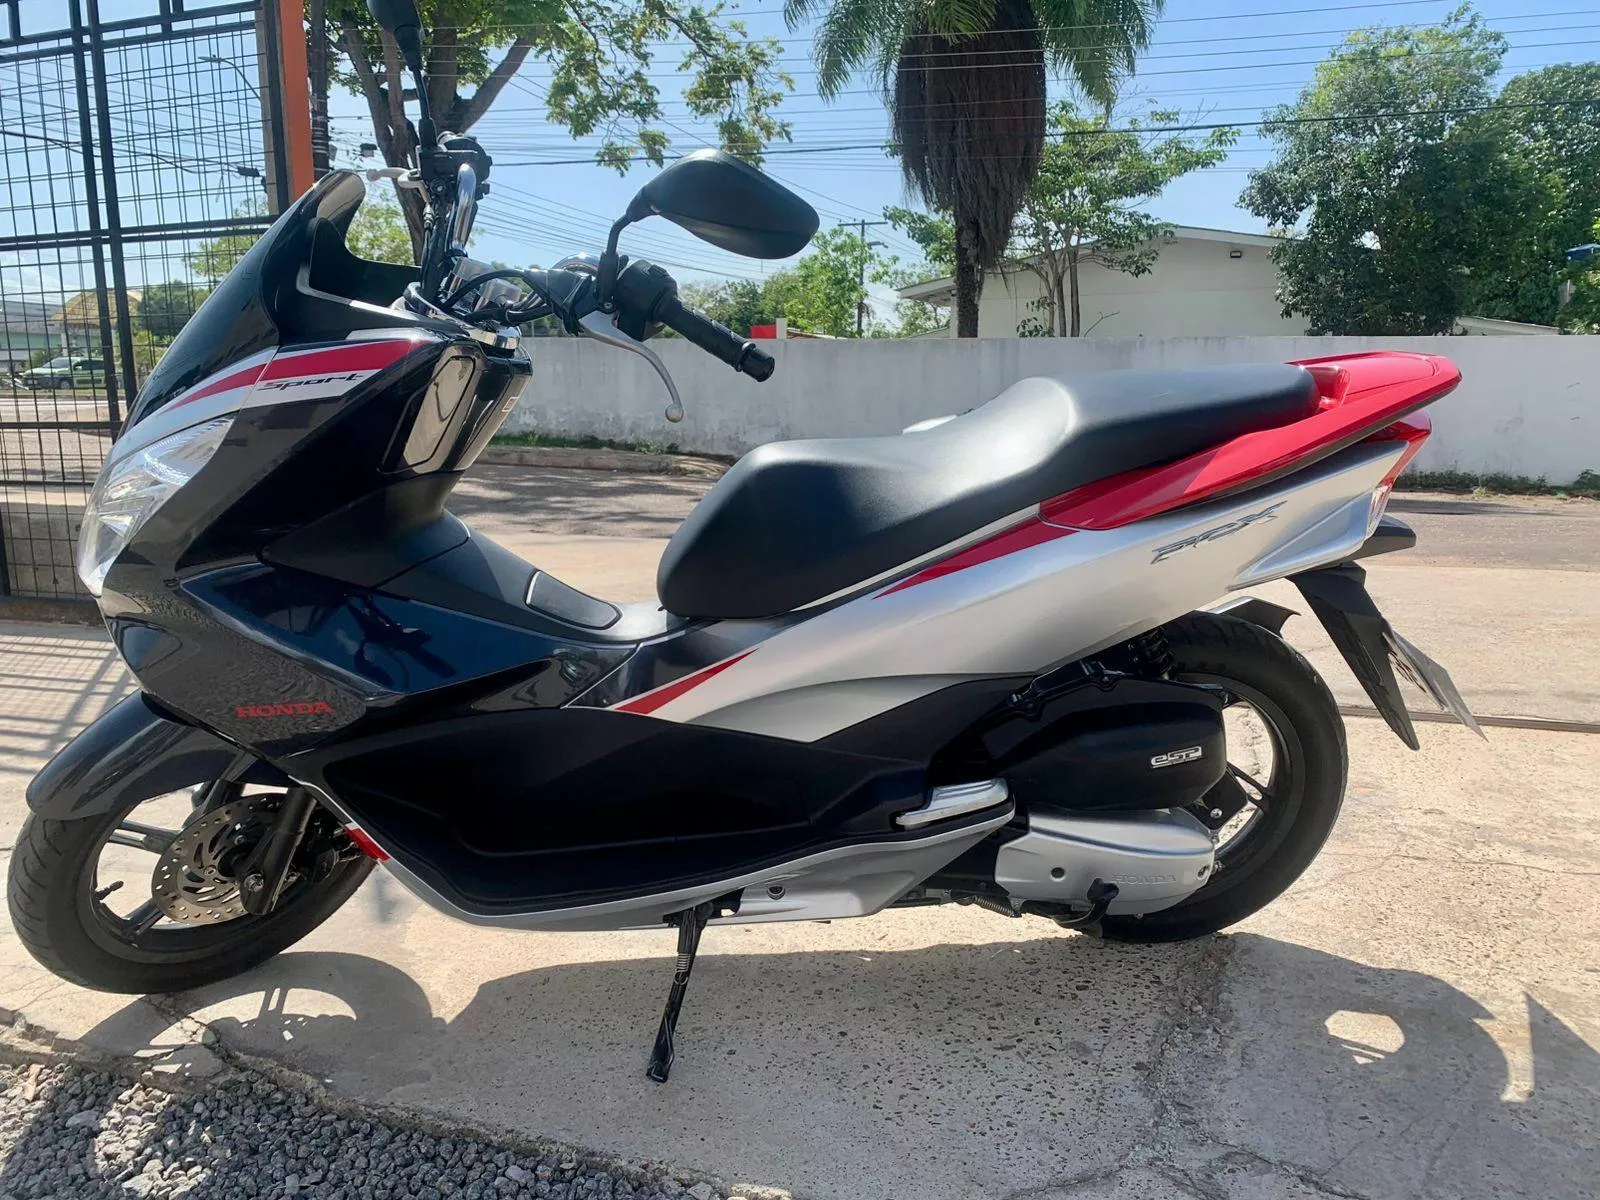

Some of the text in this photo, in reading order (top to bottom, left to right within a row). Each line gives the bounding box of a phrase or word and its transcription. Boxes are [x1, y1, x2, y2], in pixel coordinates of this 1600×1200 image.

[258, 373, 365, 391] Sport
[235, 701, 335, 718] HONDA
[1111, 874, 1177, 885] HONDA
